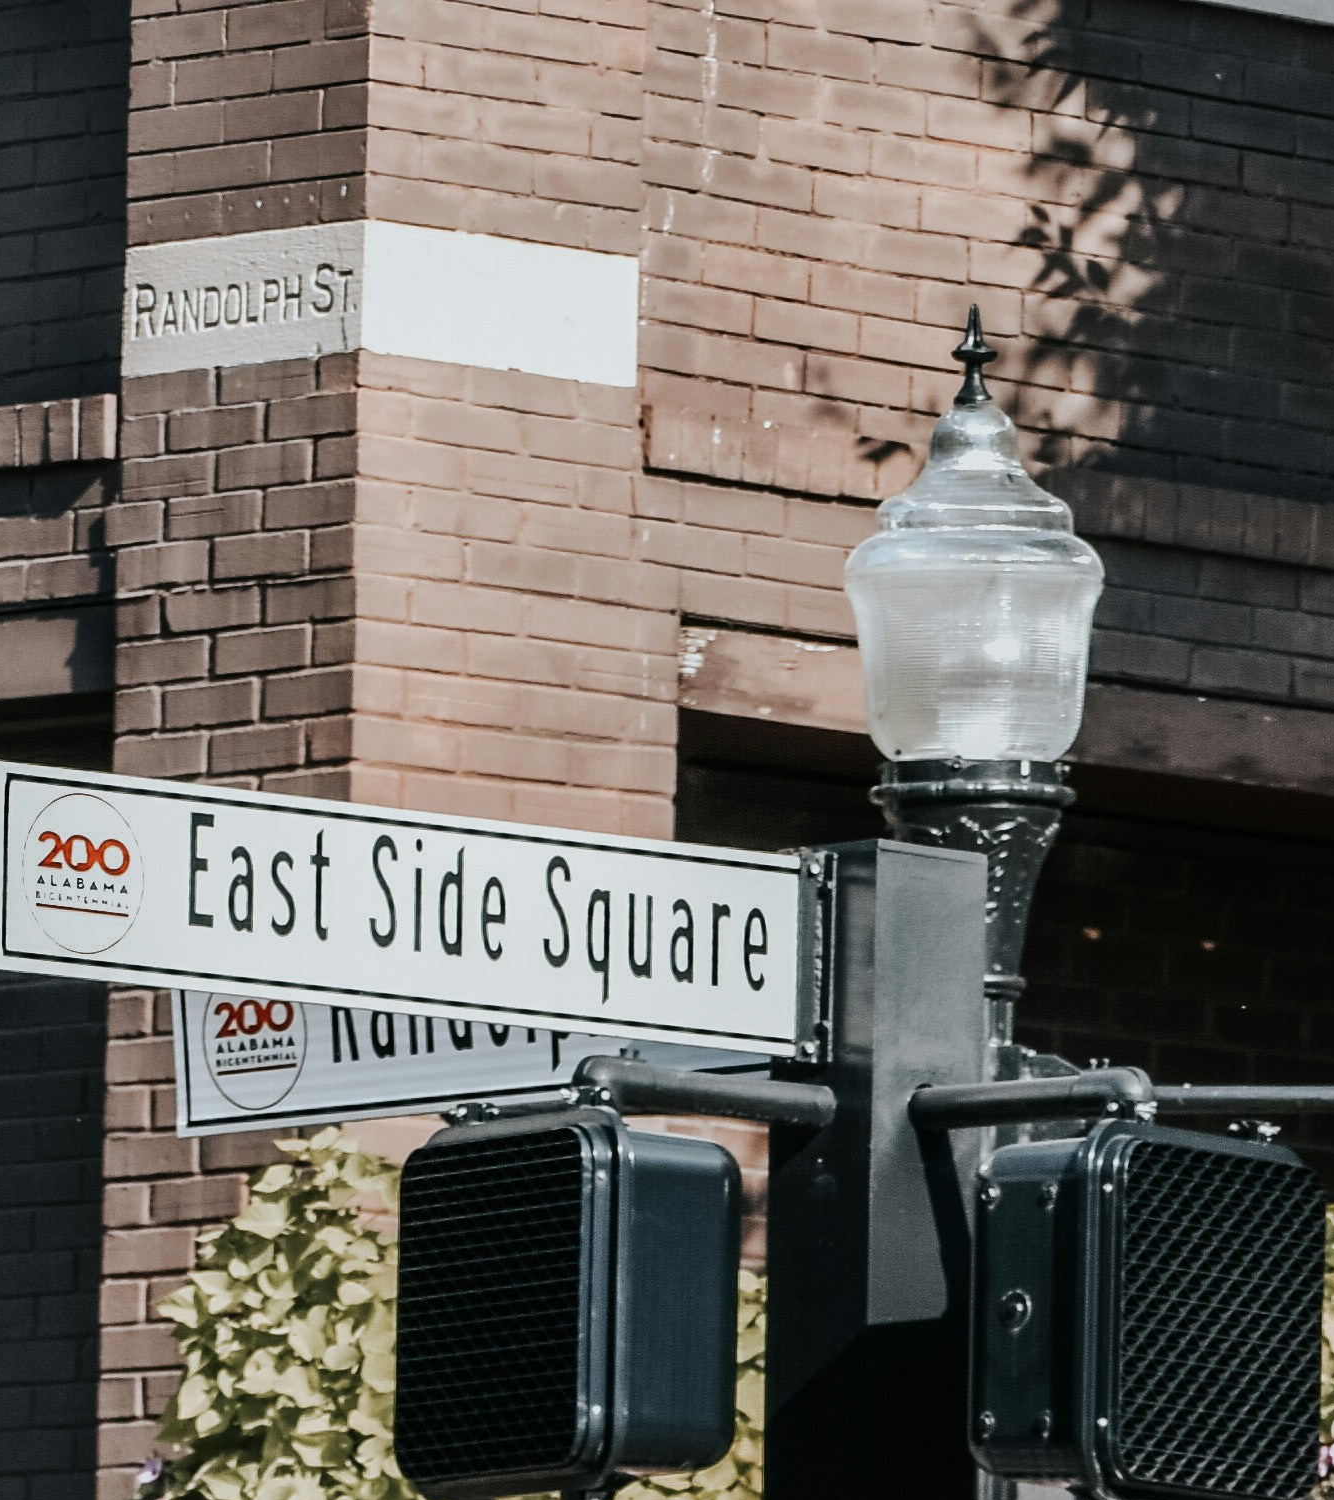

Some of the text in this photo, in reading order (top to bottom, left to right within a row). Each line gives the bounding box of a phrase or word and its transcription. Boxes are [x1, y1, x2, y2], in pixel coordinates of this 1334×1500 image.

[129, 262, 358, 339] RANDOLPH ST.
[37, 830, 131, 877] 200
[36, 874, 129, 895] ALABAMA
[187, 811, 770, 1005] East Side Square
[213, 999, 295, 1039] 200
[215, 1034, 296, 1055] ALABAMA
